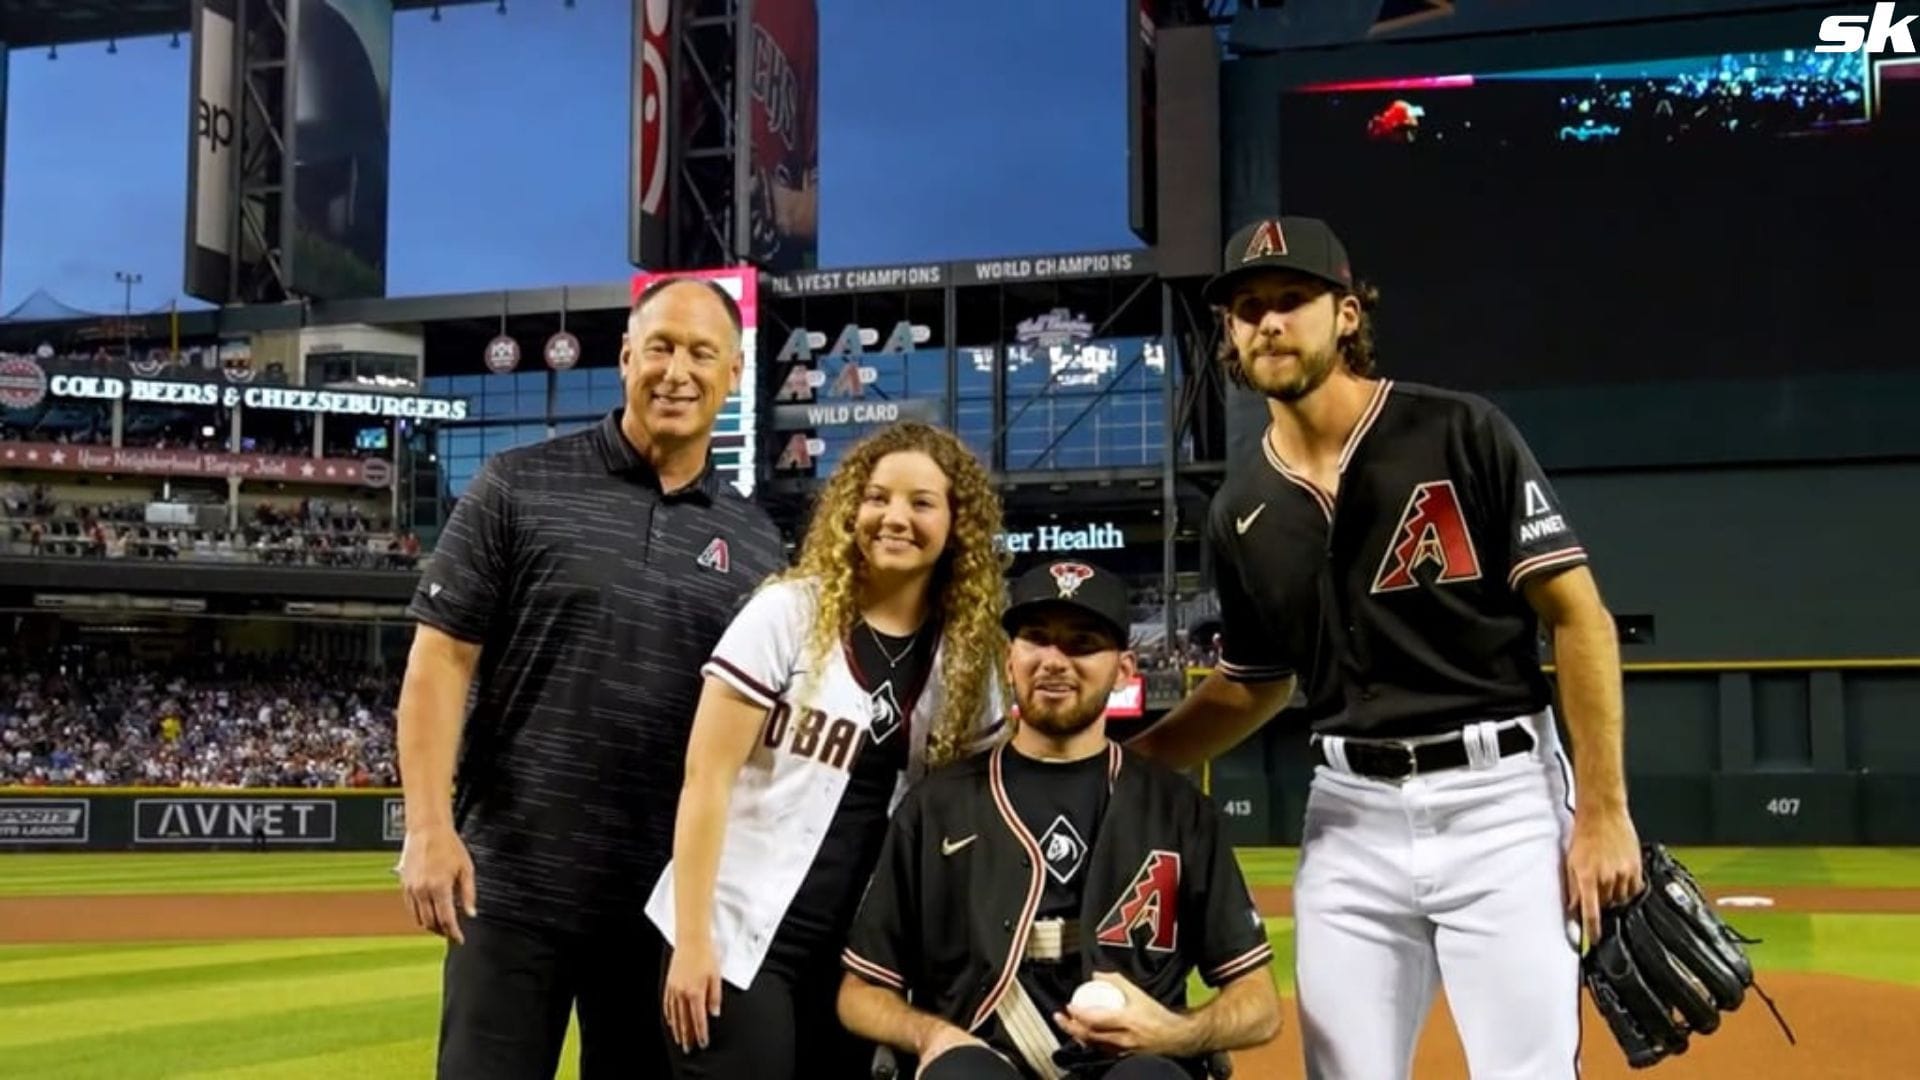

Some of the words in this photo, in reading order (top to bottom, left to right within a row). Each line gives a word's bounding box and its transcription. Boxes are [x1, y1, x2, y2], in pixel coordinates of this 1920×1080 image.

[772, 276, 793, 292] NL
[796, 271, 841, 292] WEST
[846, 265, 940, 288] CHAMPIONS
[975, 260, 1030, 281] WORLD
[1035, 253, 1133, 276] CHAMPIONS
[50, 375, 125, 399] COLD
[130, 379, 218, 405] BEERS
[222, 386, 241, 408] &
[244, 387, 467, 420] CHEESEBURGERS
[807, 405, 849, 425] WILD
[853, 403, 898, 423] CARD
[1037, 521, 1125, 551] Health
[1223, 800, 1252, 817] 413
[1766, 797, 1801, 816] 407
[157, 804, 315, 837] AVNET
